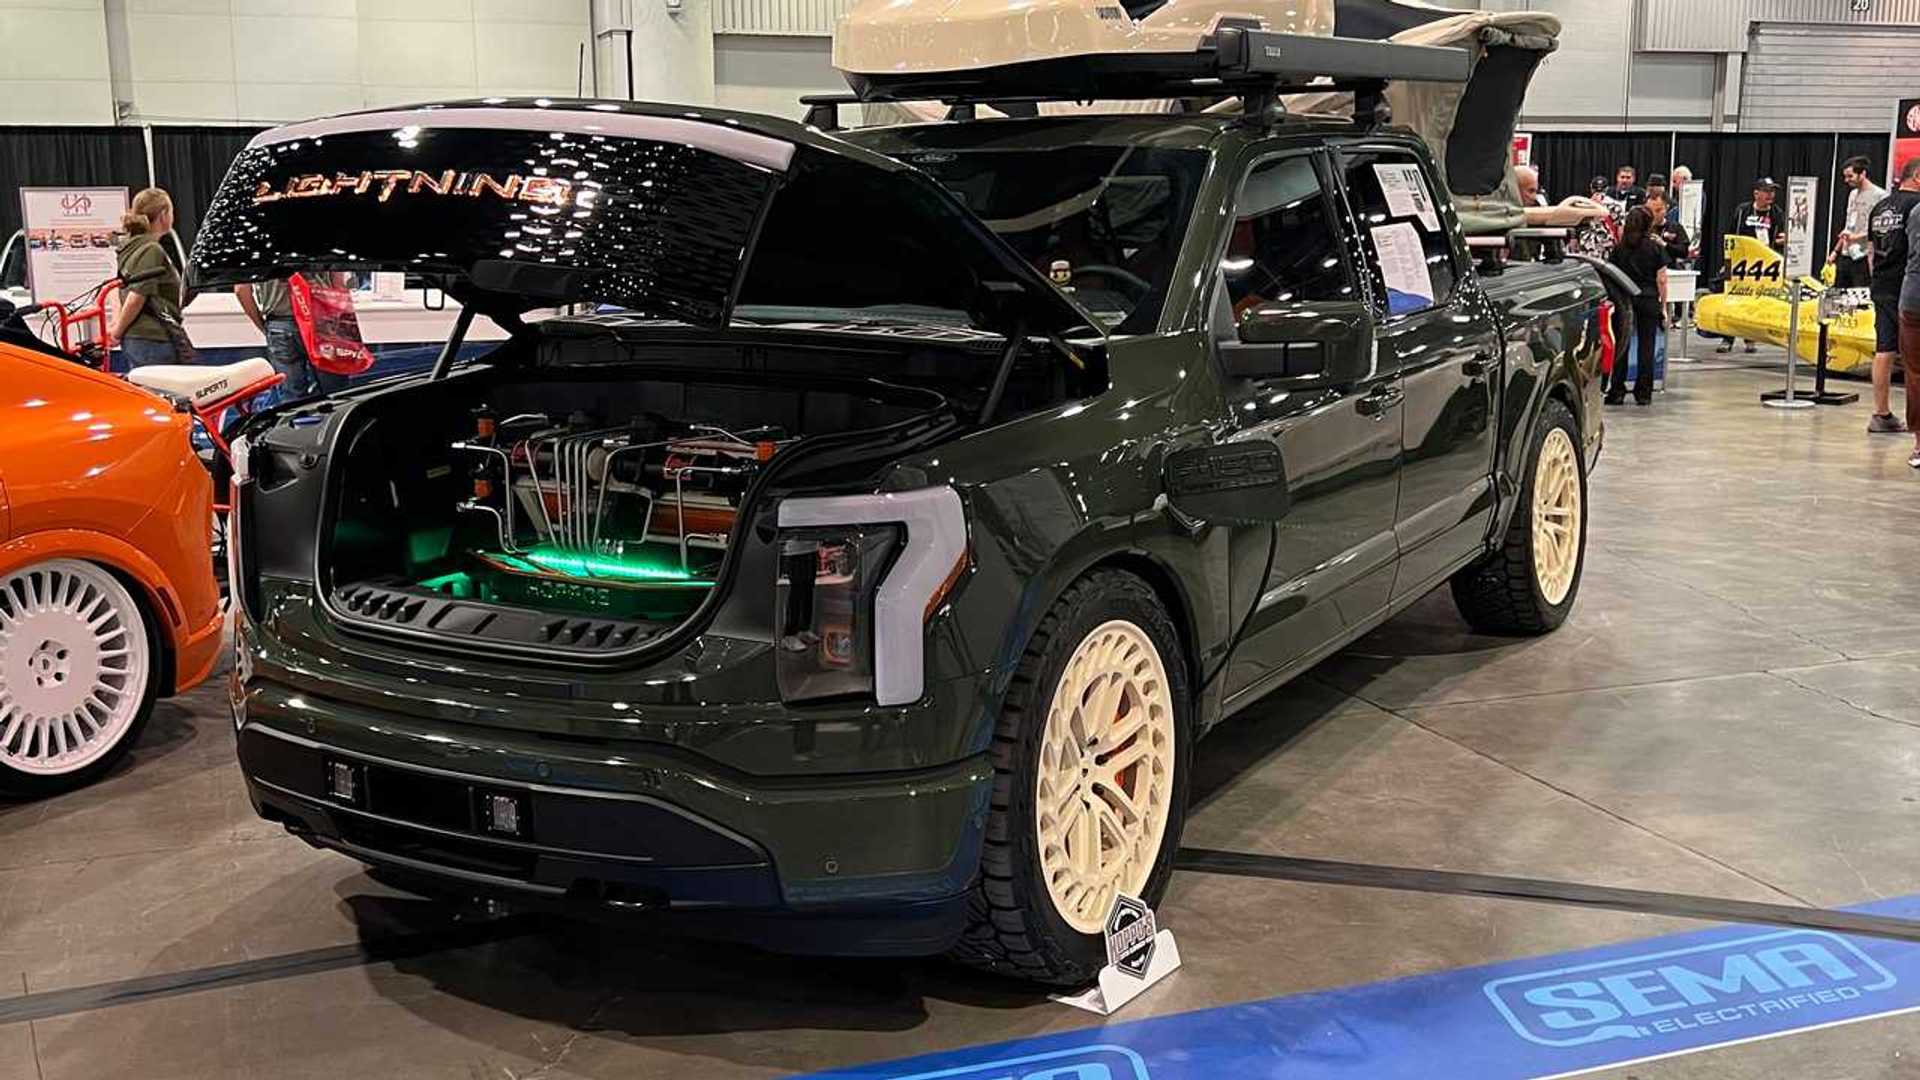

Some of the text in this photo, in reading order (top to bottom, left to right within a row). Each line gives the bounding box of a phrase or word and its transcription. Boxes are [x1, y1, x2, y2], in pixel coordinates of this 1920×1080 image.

[1851, 0, 1869, 10] 20
[251, 169, 571, 204] LIGHTNING
[1524, 942, 1858, 1030] SEMA
[1656, 986, 1865, 1034] ELECTRIFIED
